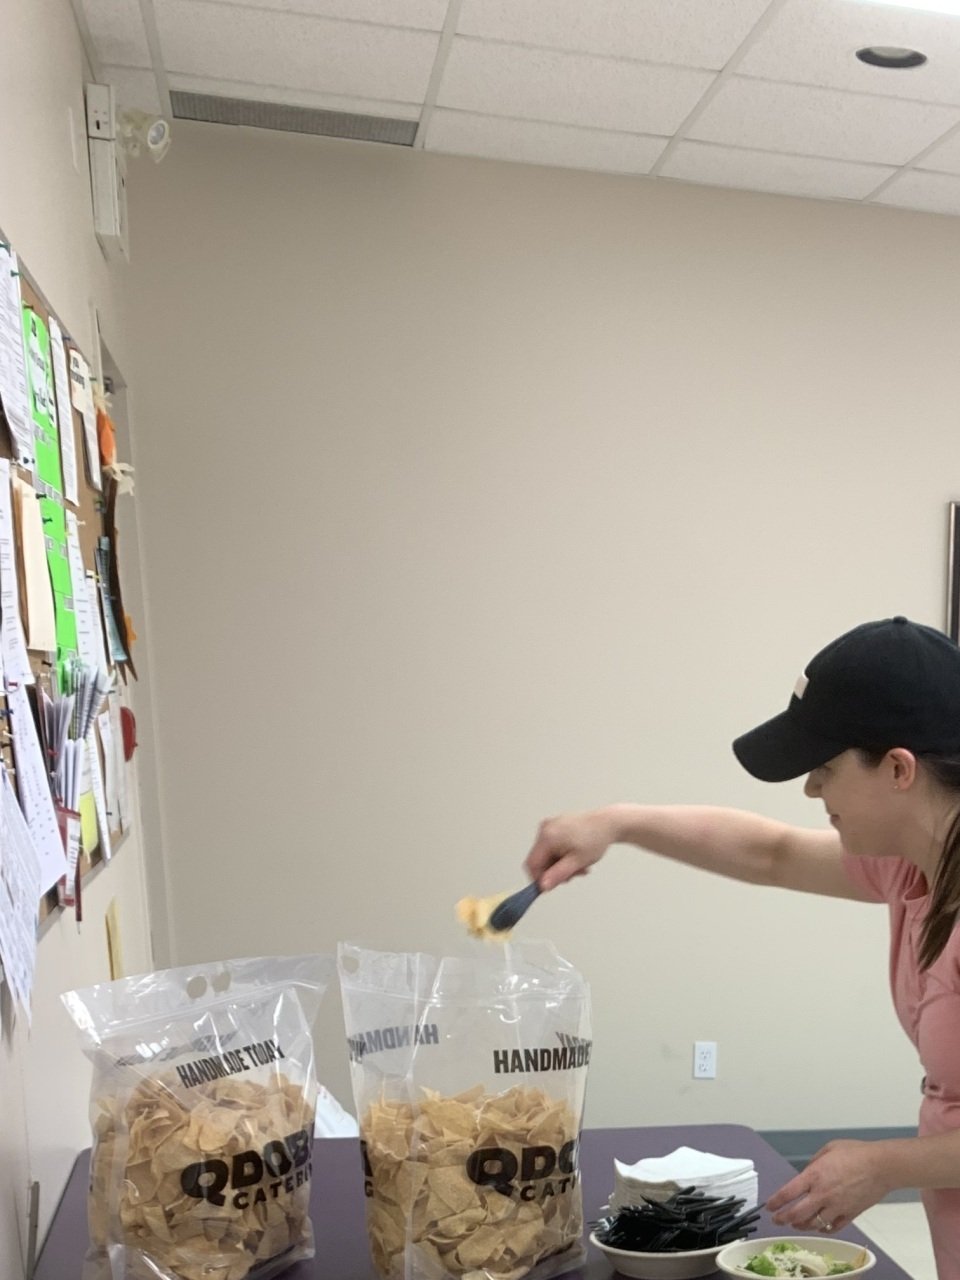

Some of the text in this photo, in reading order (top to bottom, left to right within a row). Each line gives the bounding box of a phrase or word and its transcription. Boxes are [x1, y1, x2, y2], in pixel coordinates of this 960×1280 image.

[176, 1049, 250, 1089] HANDMADE
[242, 1038, 285, 1068] TODAY
[180, 1128, 310, 1207] QDOB
[520, 1176, 576, 1201] CAT
